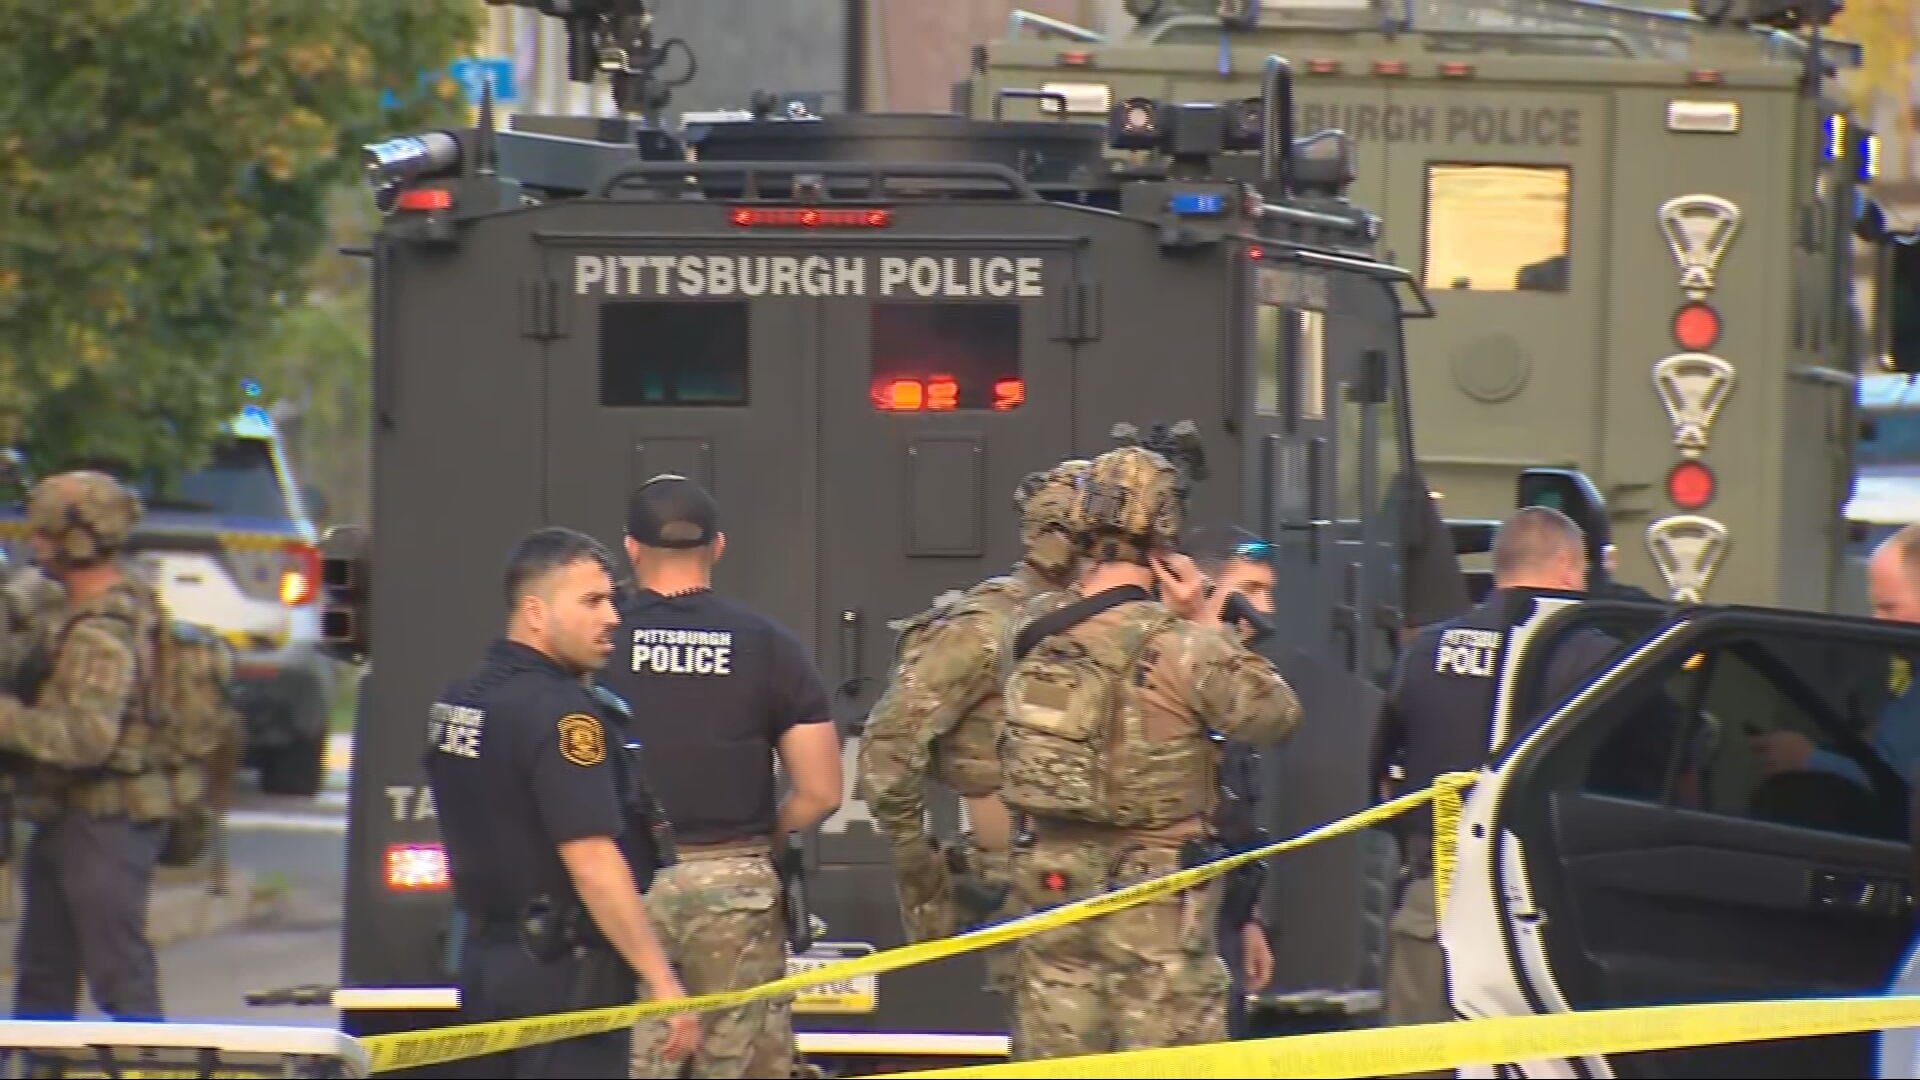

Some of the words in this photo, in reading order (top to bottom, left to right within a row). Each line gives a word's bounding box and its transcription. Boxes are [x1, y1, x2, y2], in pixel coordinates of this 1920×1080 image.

[1446, 104, 1581, 146] POLICE
[575, 255, 866, 296] PITTSBURGH
[880, 256, 1044, 297] POLICE
[632, 629, 731, 646] PITTSBURGH
[631, 645, 731, 675] POLICE
